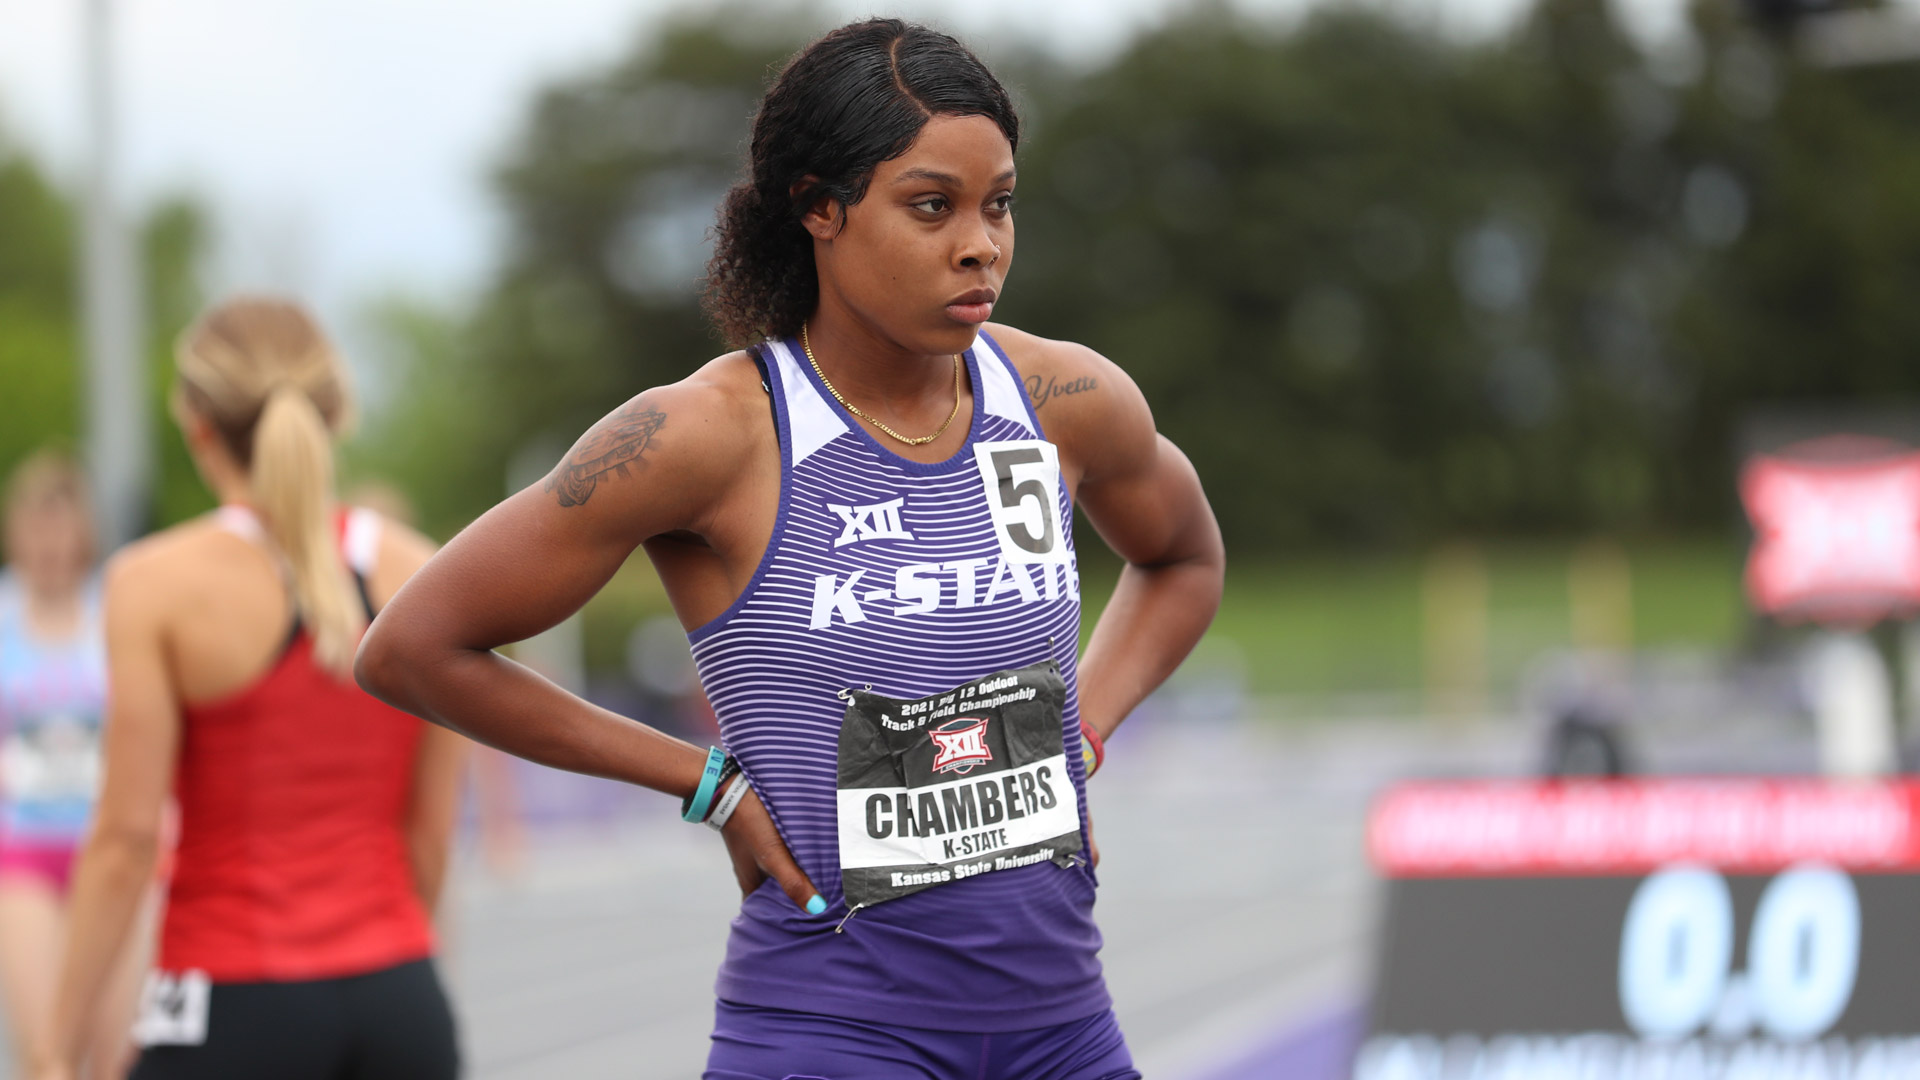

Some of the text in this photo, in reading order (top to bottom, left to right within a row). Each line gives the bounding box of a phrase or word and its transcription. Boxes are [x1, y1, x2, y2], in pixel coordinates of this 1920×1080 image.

[1023, 374, 1098, 411] Yvette
[990, 447, 1054, 555] 5
[826, 496, 915, 549] XII
[881, 713, 915, 731] Track
[959, 686, 1037, 713] Championship
[901, 700, 934, 716] 2021
[959, 686, 976, 699] 12
[978, 675, 1019, 695] Outdoor
[934, 724, 988, 766] XII
[865, 765, 1057, 840] CHAMBERS
[942, 827, 1009, 860] K-STATE
[890, 847, 1055, 887] Kansas State University
